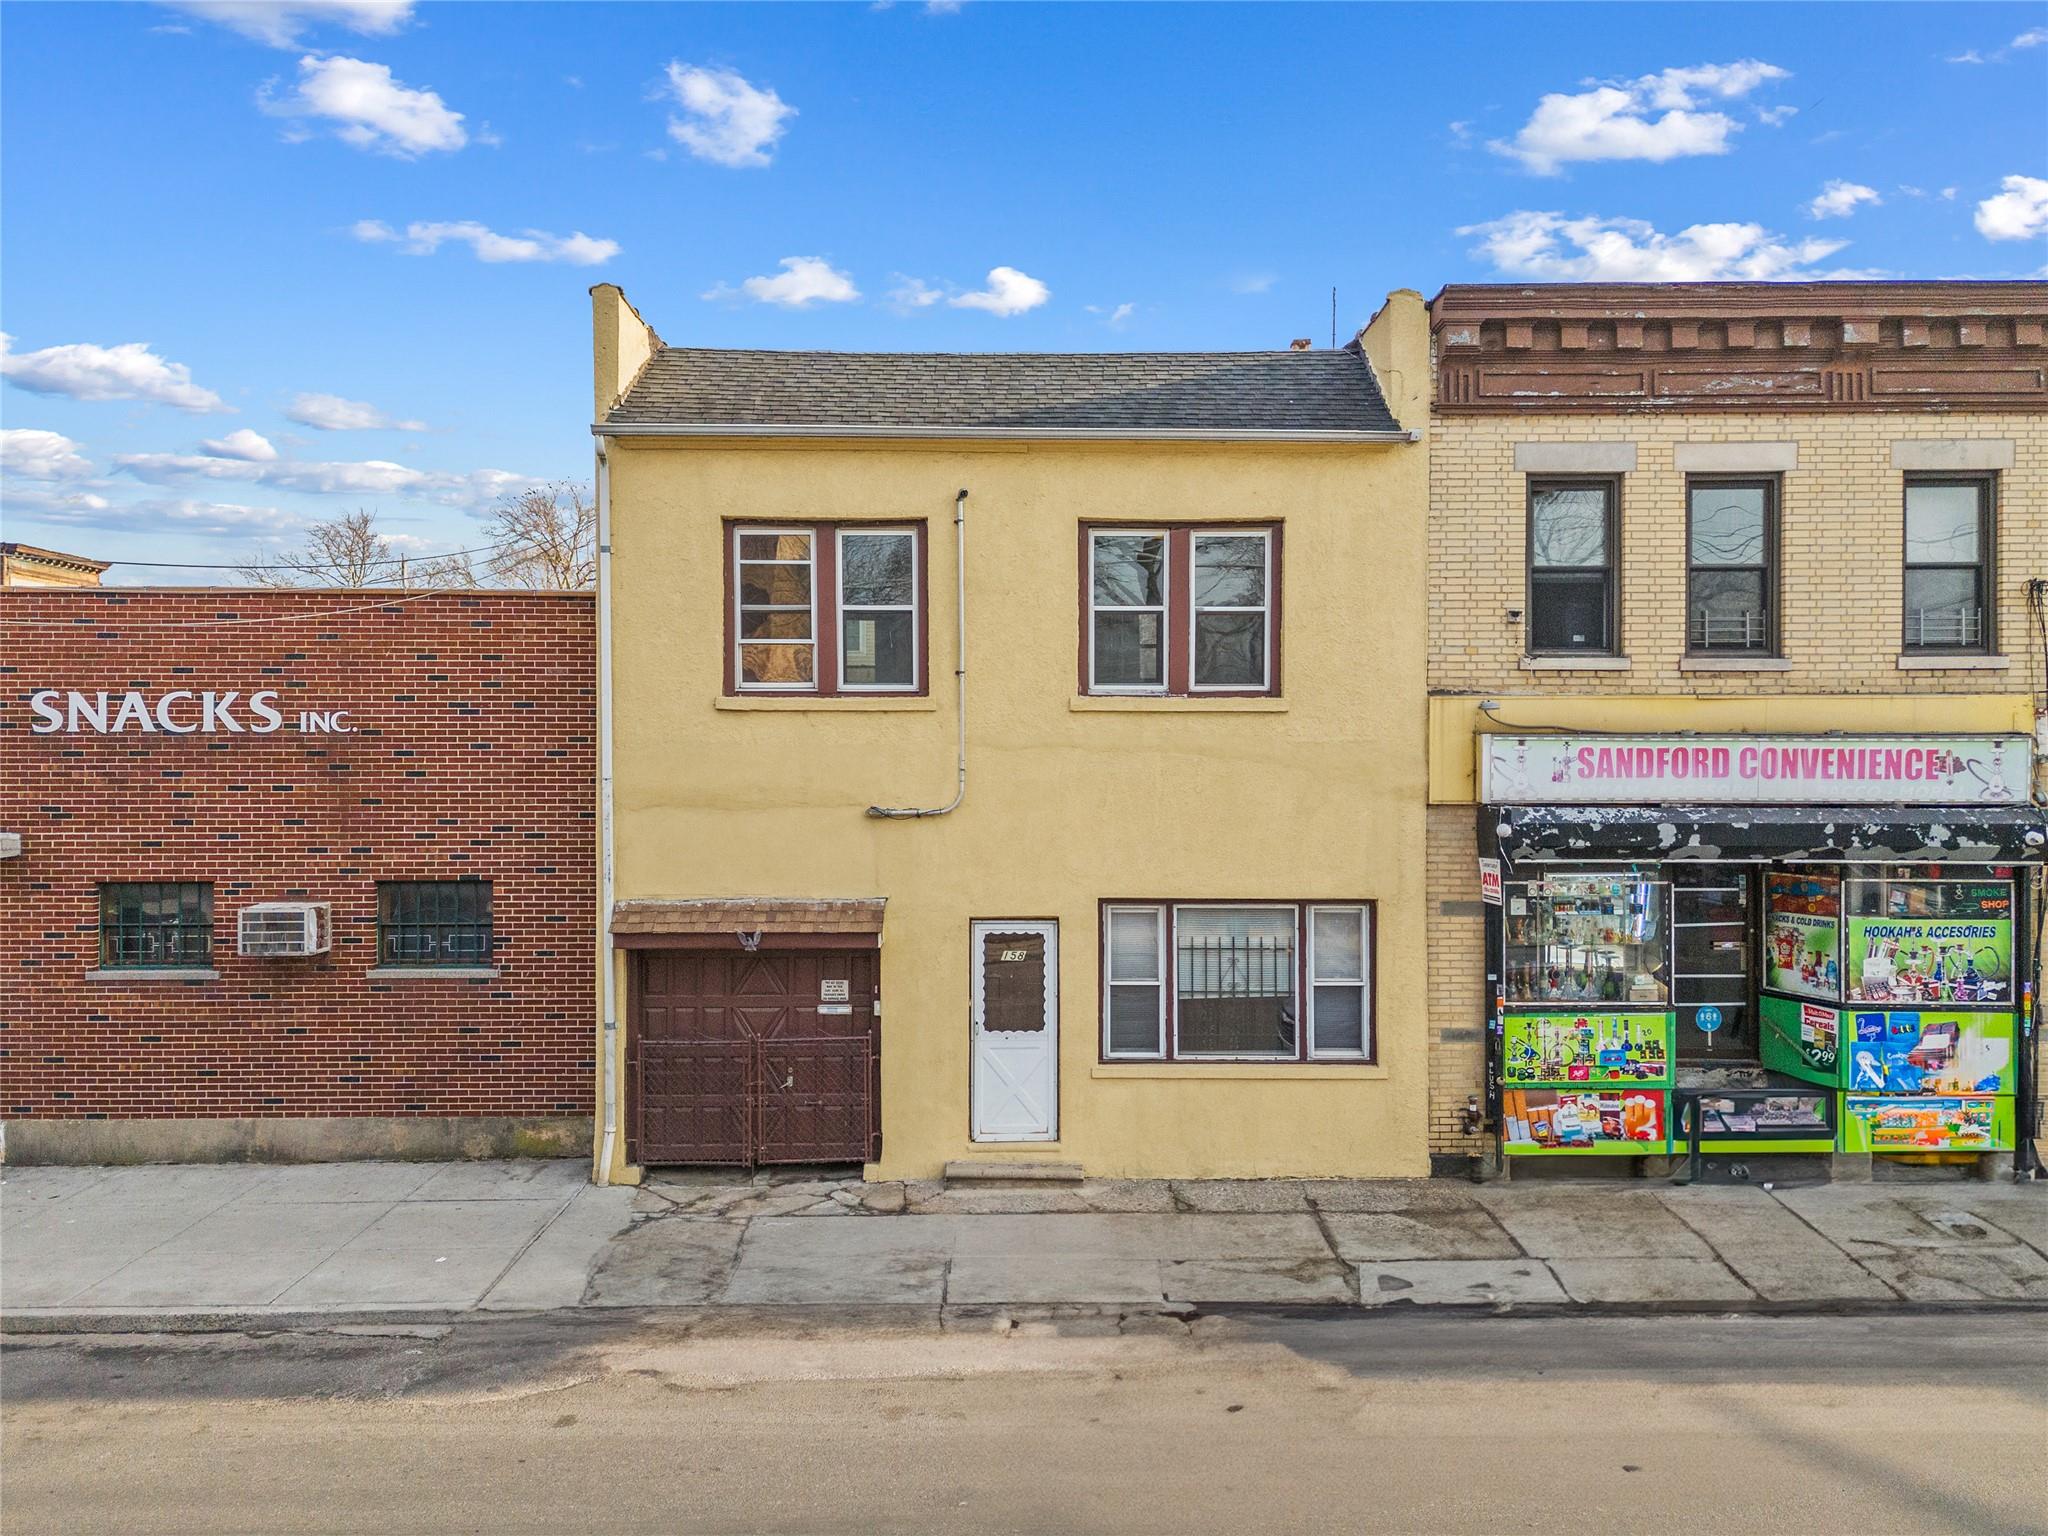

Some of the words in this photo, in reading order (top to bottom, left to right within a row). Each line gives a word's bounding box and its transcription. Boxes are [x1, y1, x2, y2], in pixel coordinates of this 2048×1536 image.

[31, 690, 283, 734] SNACKS
[299, 711, 358, 733] INC.
[1577, 747, 1730, 779] SANDFORD
[1739, 747, 1939, 780] CONVENIENCE
[1483, 872, 1500, 888] ATM
[1971, 888, 2008, 897] SMOKE
[1980, 900, 2010, 909] SHOP
[1797, 916, 1812, 926] COLD
[1813, 918, 1835, 929] DRINKS
[1864, 926, 1912, 938] HOOKAH
[1915, 928, 1922, 937] &
[1927, 926, 1996, 938] ACCESORIES
[1004, 951, 1025, 960] 158
[1805, 1017, 1835, 1031] Cereals
